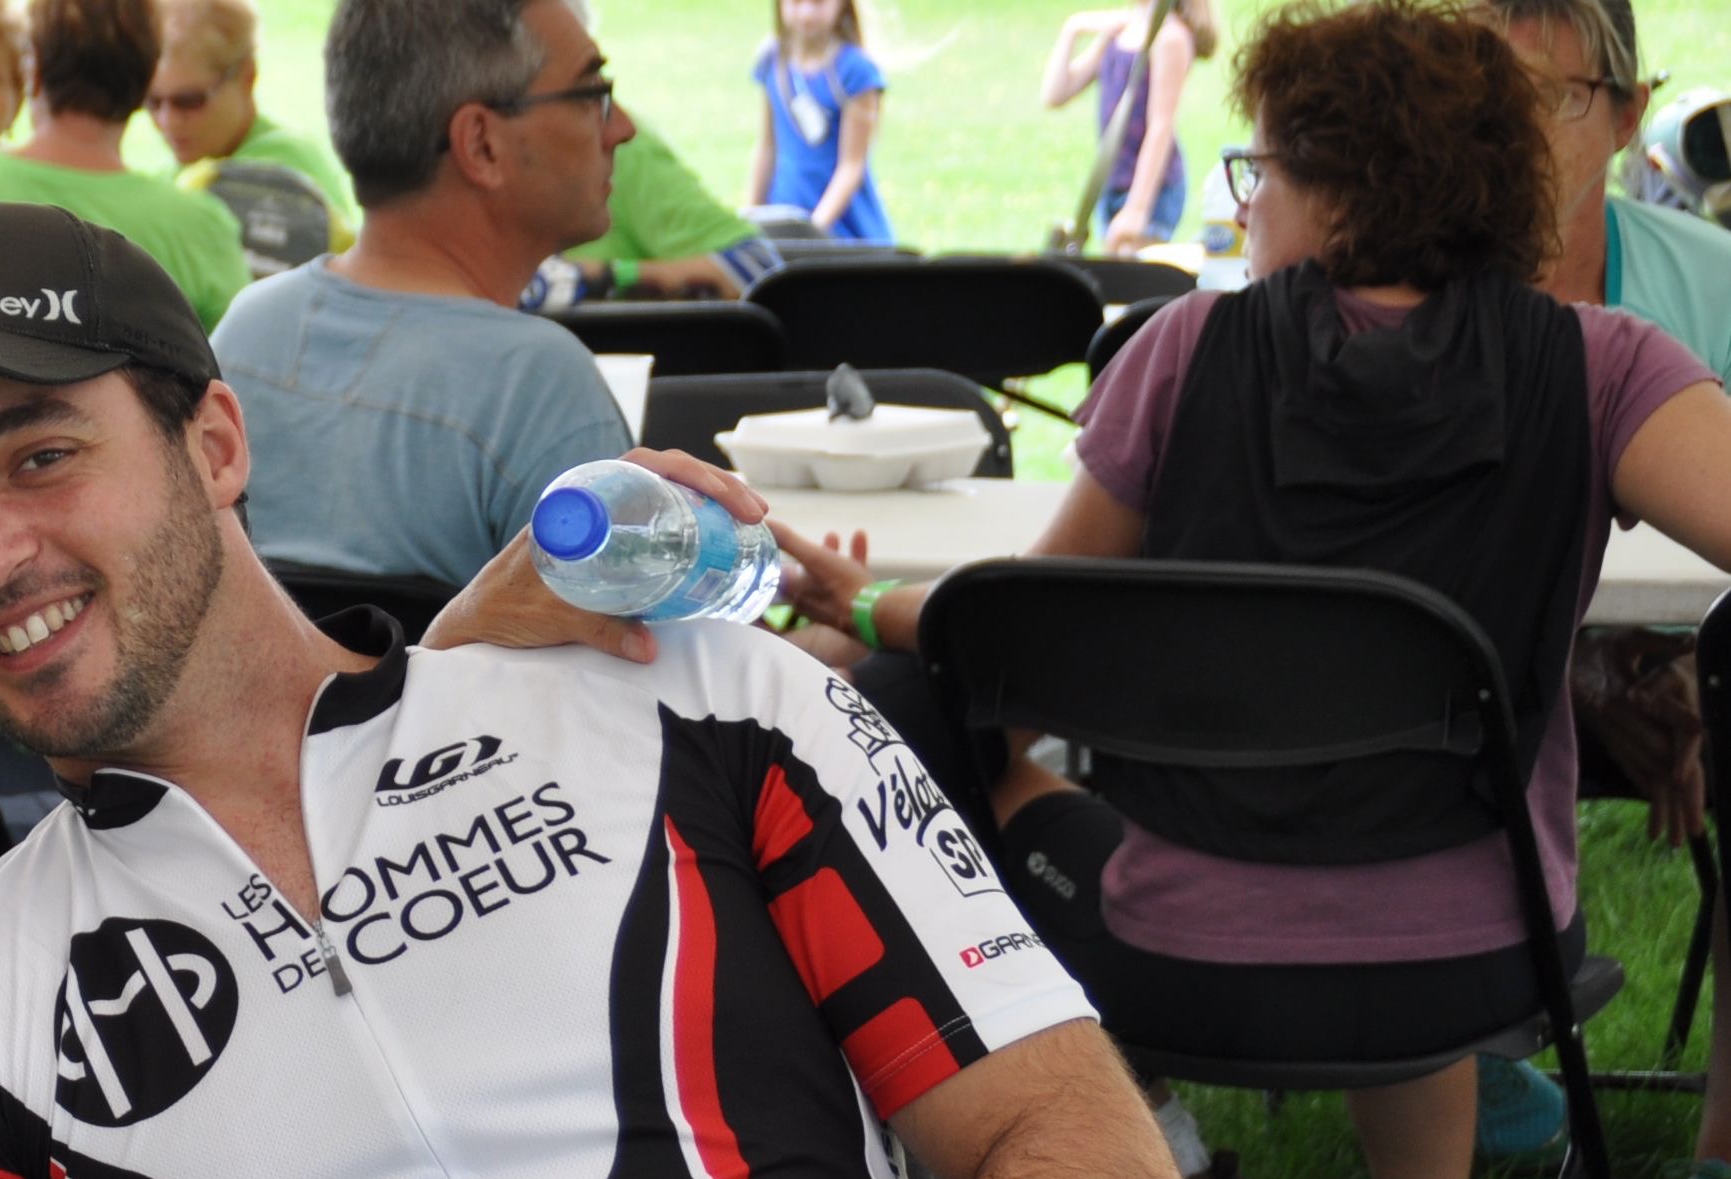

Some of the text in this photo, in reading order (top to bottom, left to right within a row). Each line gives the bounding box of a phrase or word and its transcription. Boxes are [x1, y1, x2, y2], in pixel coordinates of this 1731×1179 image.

[221, 873, 272, 920] LES
[242, 782, 574, 962] HOMMES
[273, 827, 612, 994] DE COEUR
